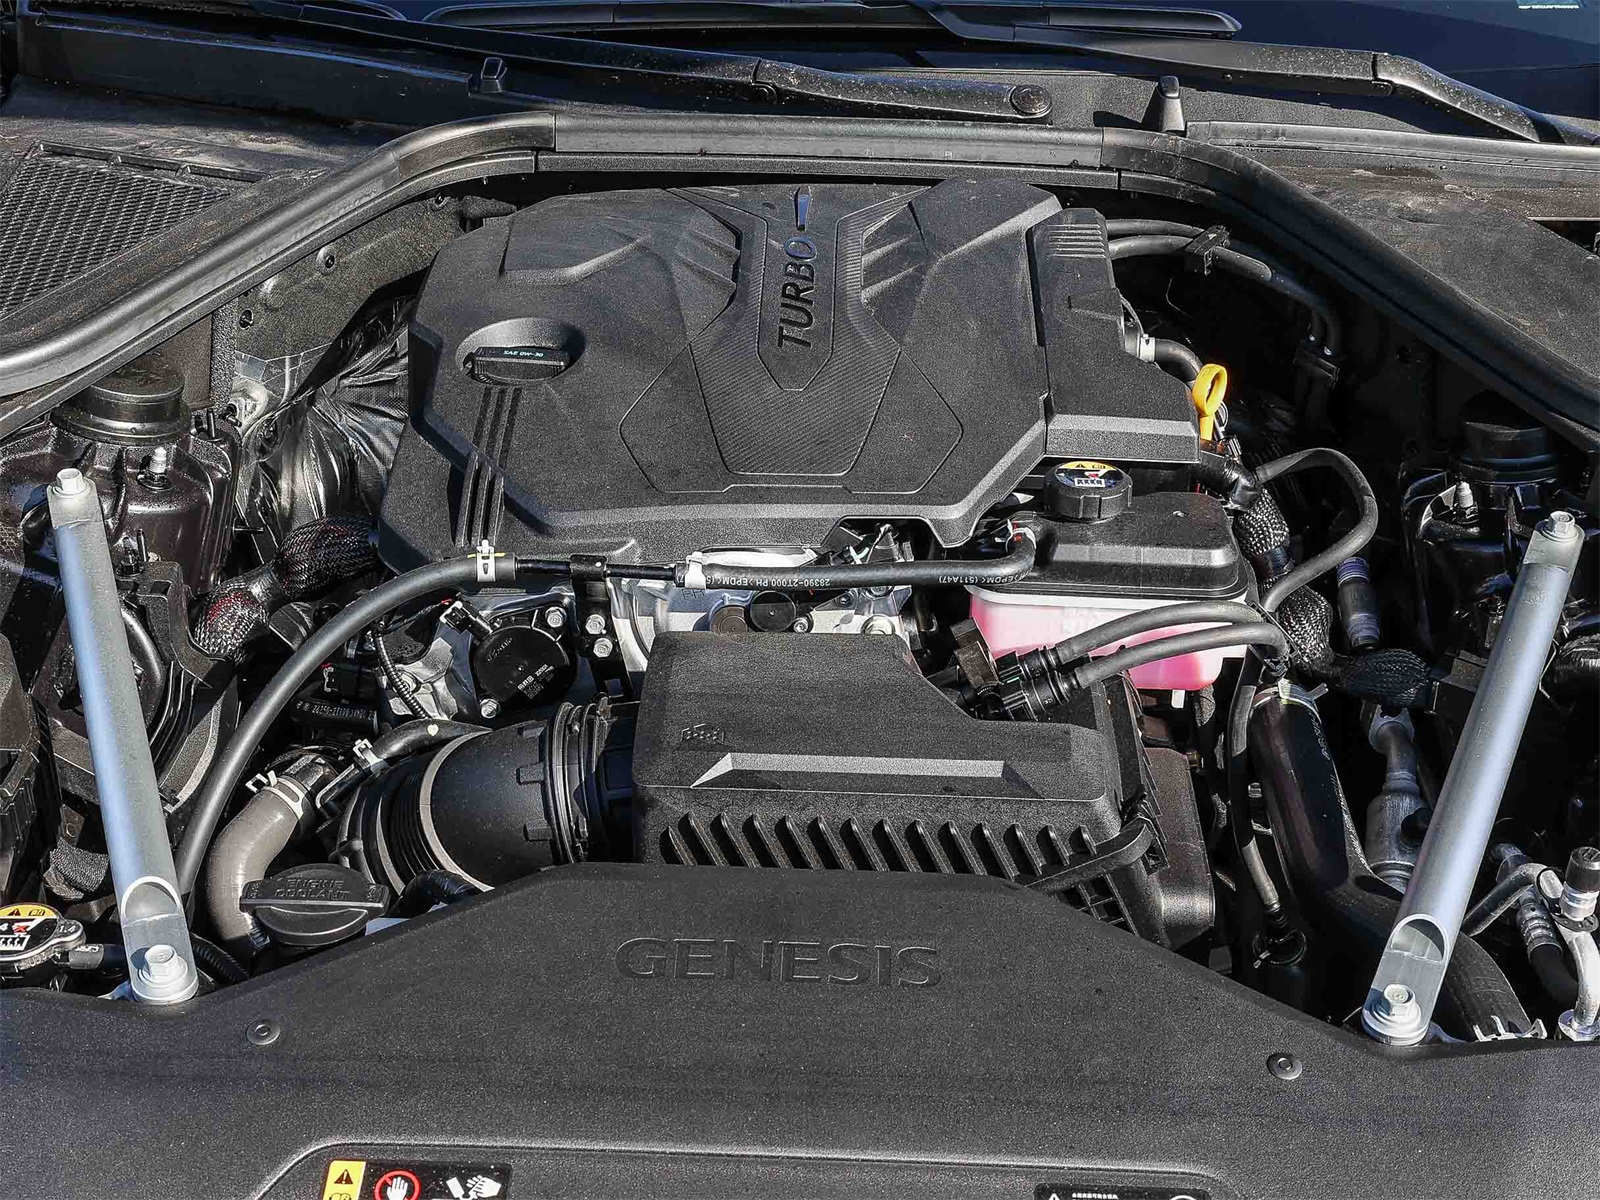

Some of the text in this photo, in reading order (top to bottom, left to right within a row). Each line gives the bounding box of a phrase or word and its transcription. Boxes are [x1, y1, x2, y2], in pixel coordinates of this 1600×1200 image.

[777, 236, 818, 348] TURBO
[755, 578, 769, 587] PH
[771, 577, 831, 587] 28390-2T000
[285, 877, 345, 889] ENGINE
[274, 888, 350, 900] COOLANT
[614, 937, 942, 985] GENESIS
